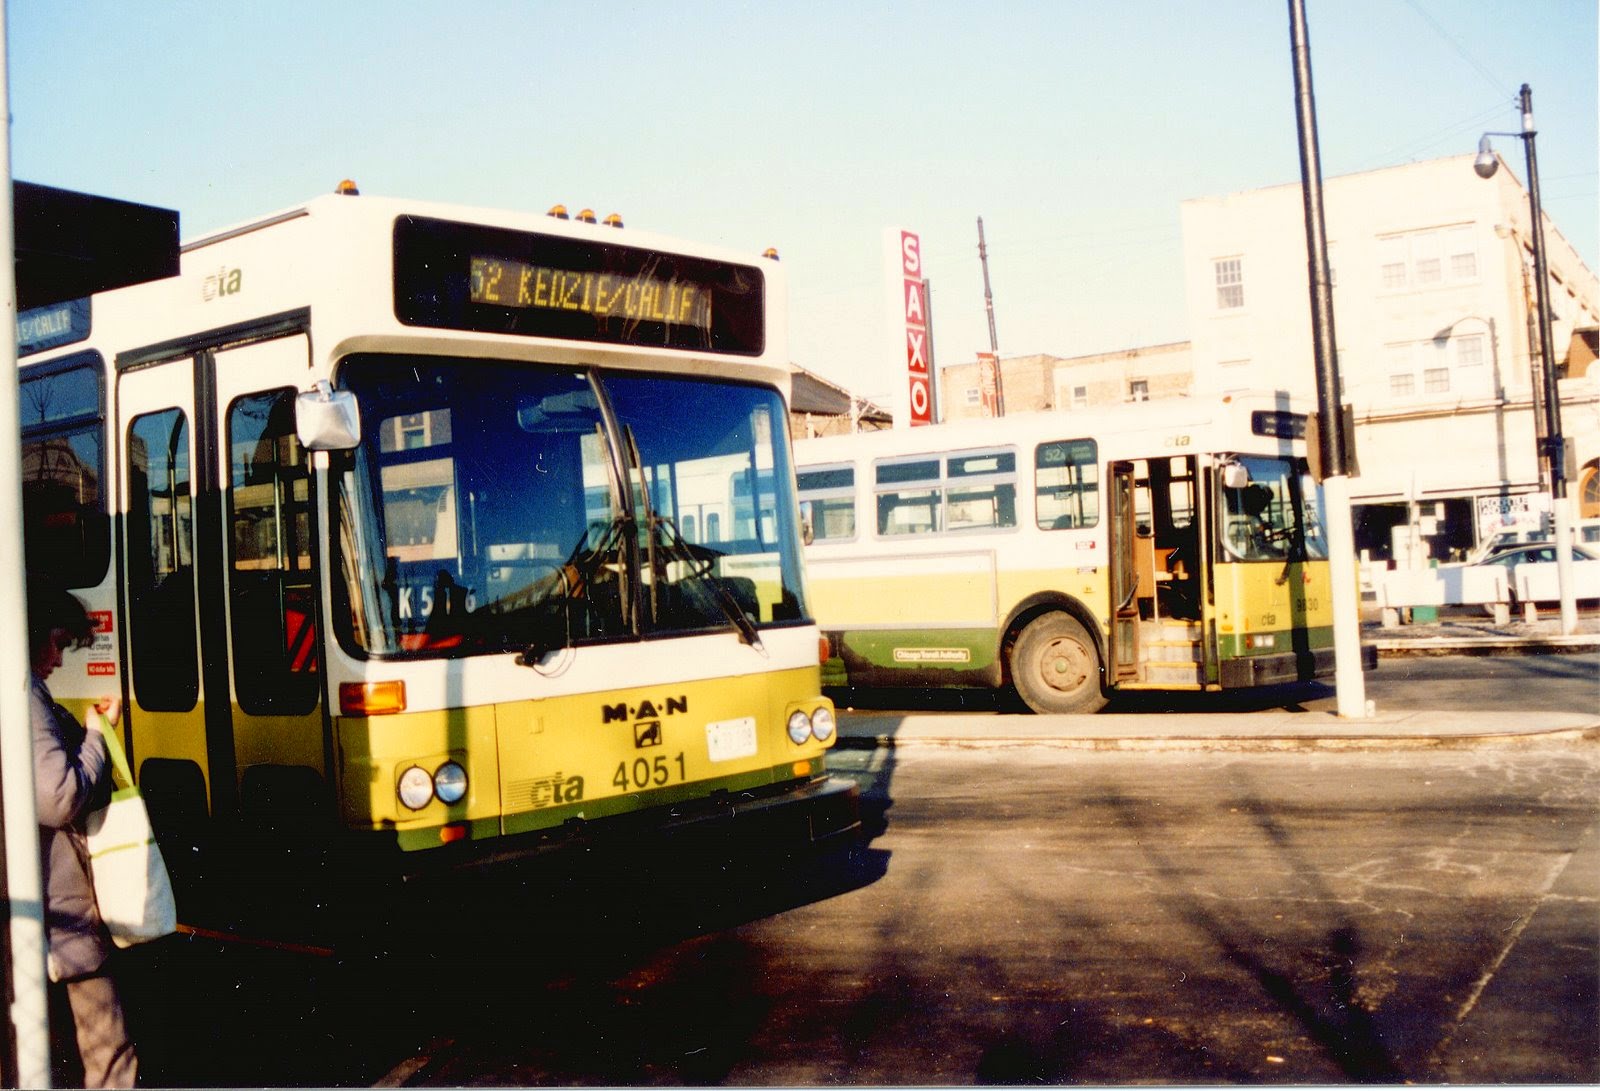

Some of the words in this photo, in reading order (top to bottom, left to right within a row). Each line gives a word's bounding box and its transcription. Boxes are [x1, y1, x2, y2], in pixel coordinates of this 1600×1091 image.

[201, 264, 243, 302] cta
[902, 235, 928, 416] SAXO
[1164, 434, 1191, 448] cta
[1261, 612, 1277, 626] cta
[531, 771, 584, 809] cta
[612, 751, 686, 792] 4051
